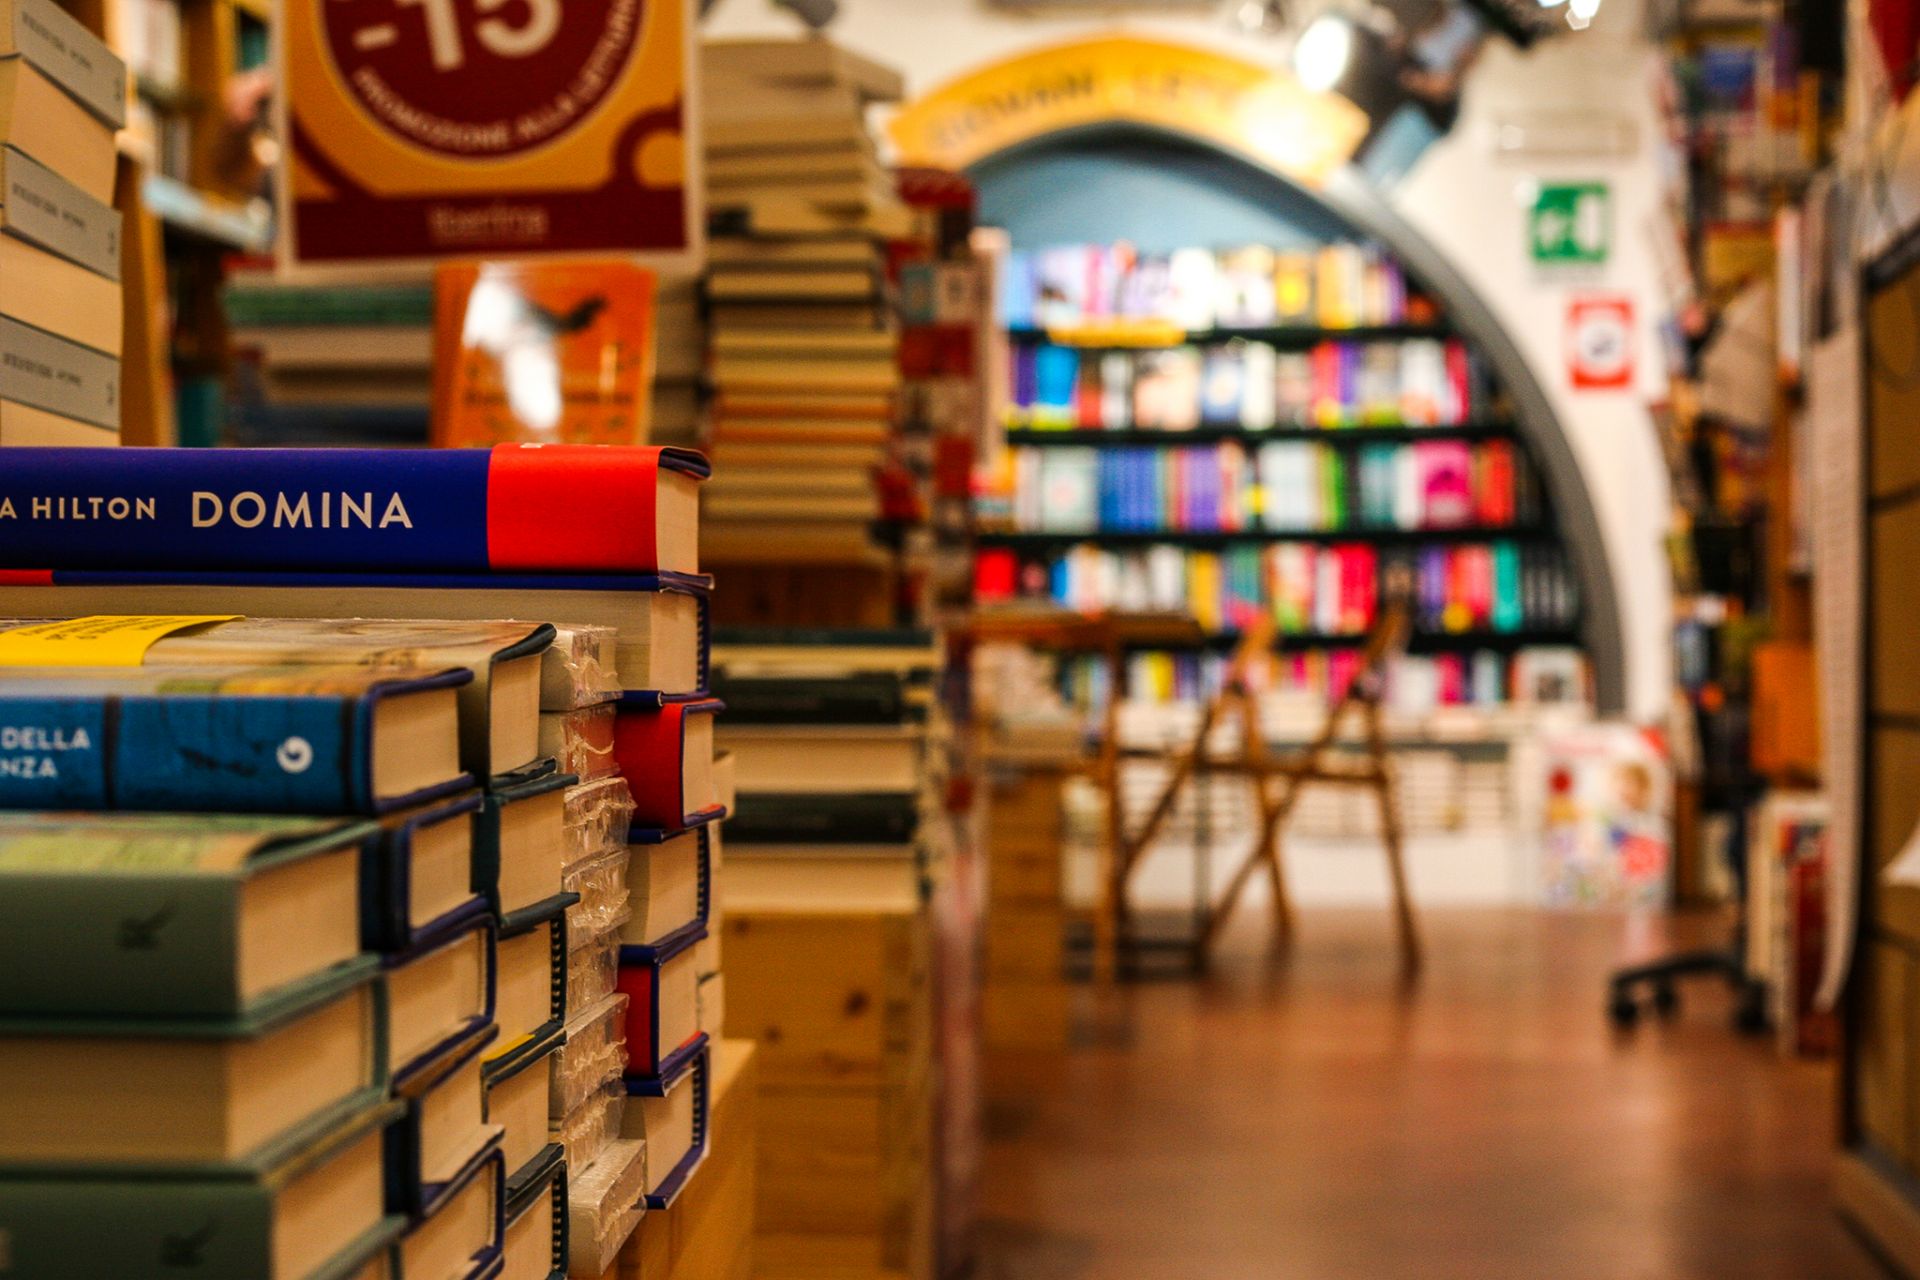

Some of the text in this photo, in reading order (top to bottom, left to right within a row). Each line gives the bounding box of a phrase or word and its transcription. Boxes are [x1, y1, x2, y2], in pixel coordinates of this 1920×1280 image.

[0, 491, 413, 529] A HILTON DOMINA
[1, 727, 91, 749] DELLA
[0, 756, 58, 778] NZA
